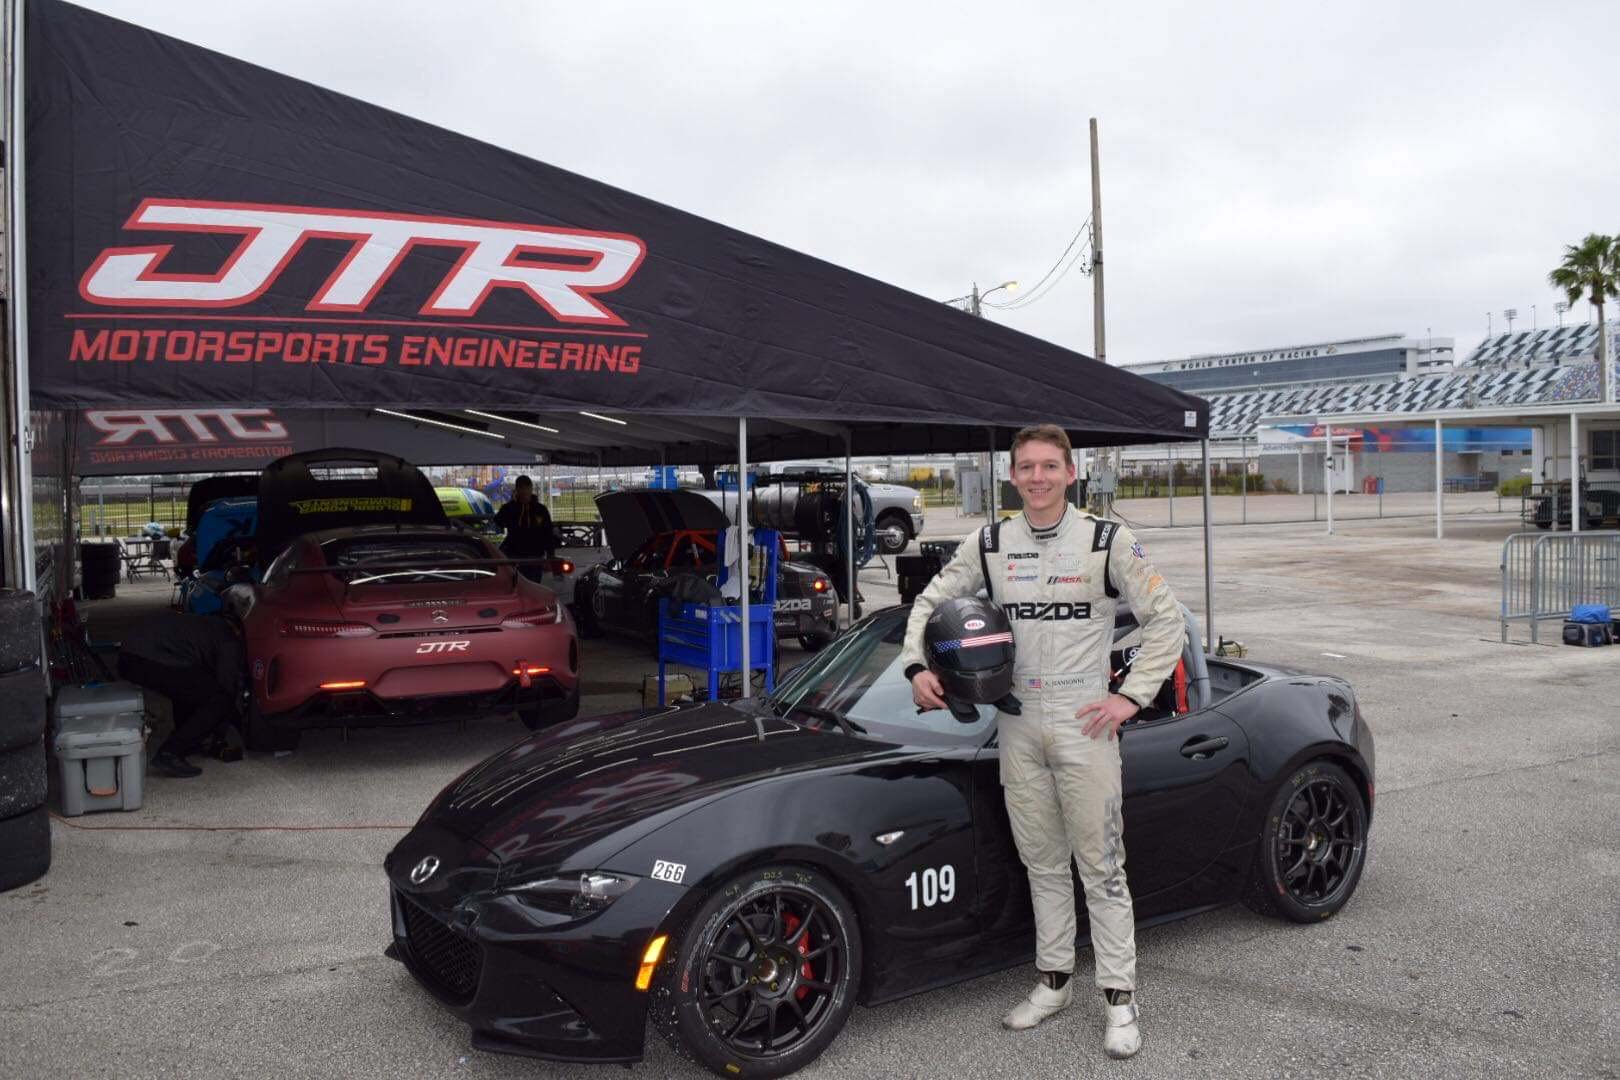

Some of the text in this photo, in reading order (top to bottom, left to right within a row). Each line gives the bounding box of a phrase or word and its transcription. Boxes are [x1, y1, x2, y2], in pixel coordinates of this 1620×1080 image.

[78, 198, 647, 326] JTR
[69, 329, 641, 375] MOTORSPORTS ENGINEERING
[1180, 349, 1319, 371] WORLD CENTER OF RACING
[416, 640, 471, 654] JTR
[653, 862, 684, 882] 266
[905, 864, 957, 911] 109
